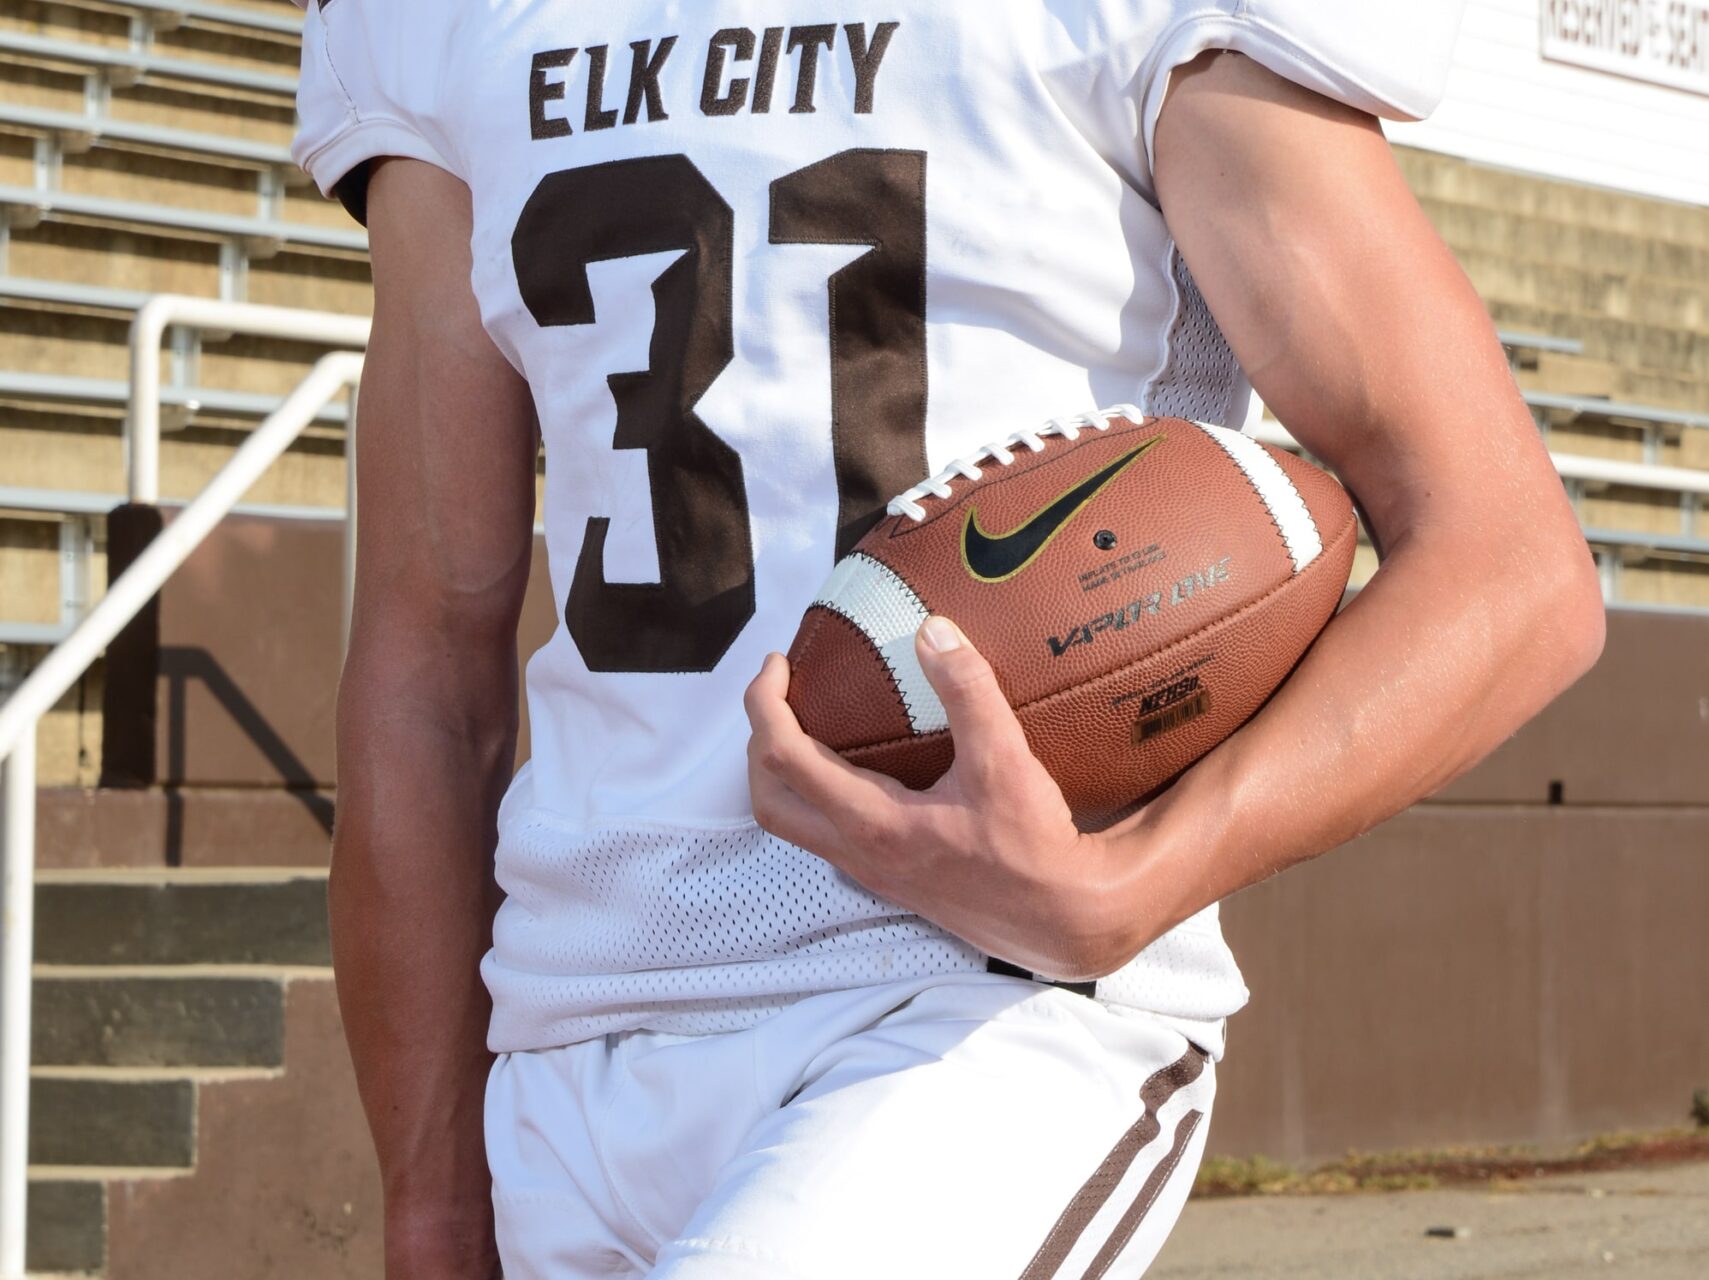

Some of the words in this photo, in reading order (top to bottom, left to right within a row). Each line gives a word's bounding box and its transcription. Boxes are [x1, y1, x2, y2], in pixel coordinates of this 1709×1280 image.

[529, 35, 679, 140] ELK
[699, 21, 901, 117] CITY
[511, 147, 929, 673] 31
[1078, 561, 1117, 583] INFLATE
[1119, 555, 1130, 565] TO
[1082, 576, 1108, 593] MADE
